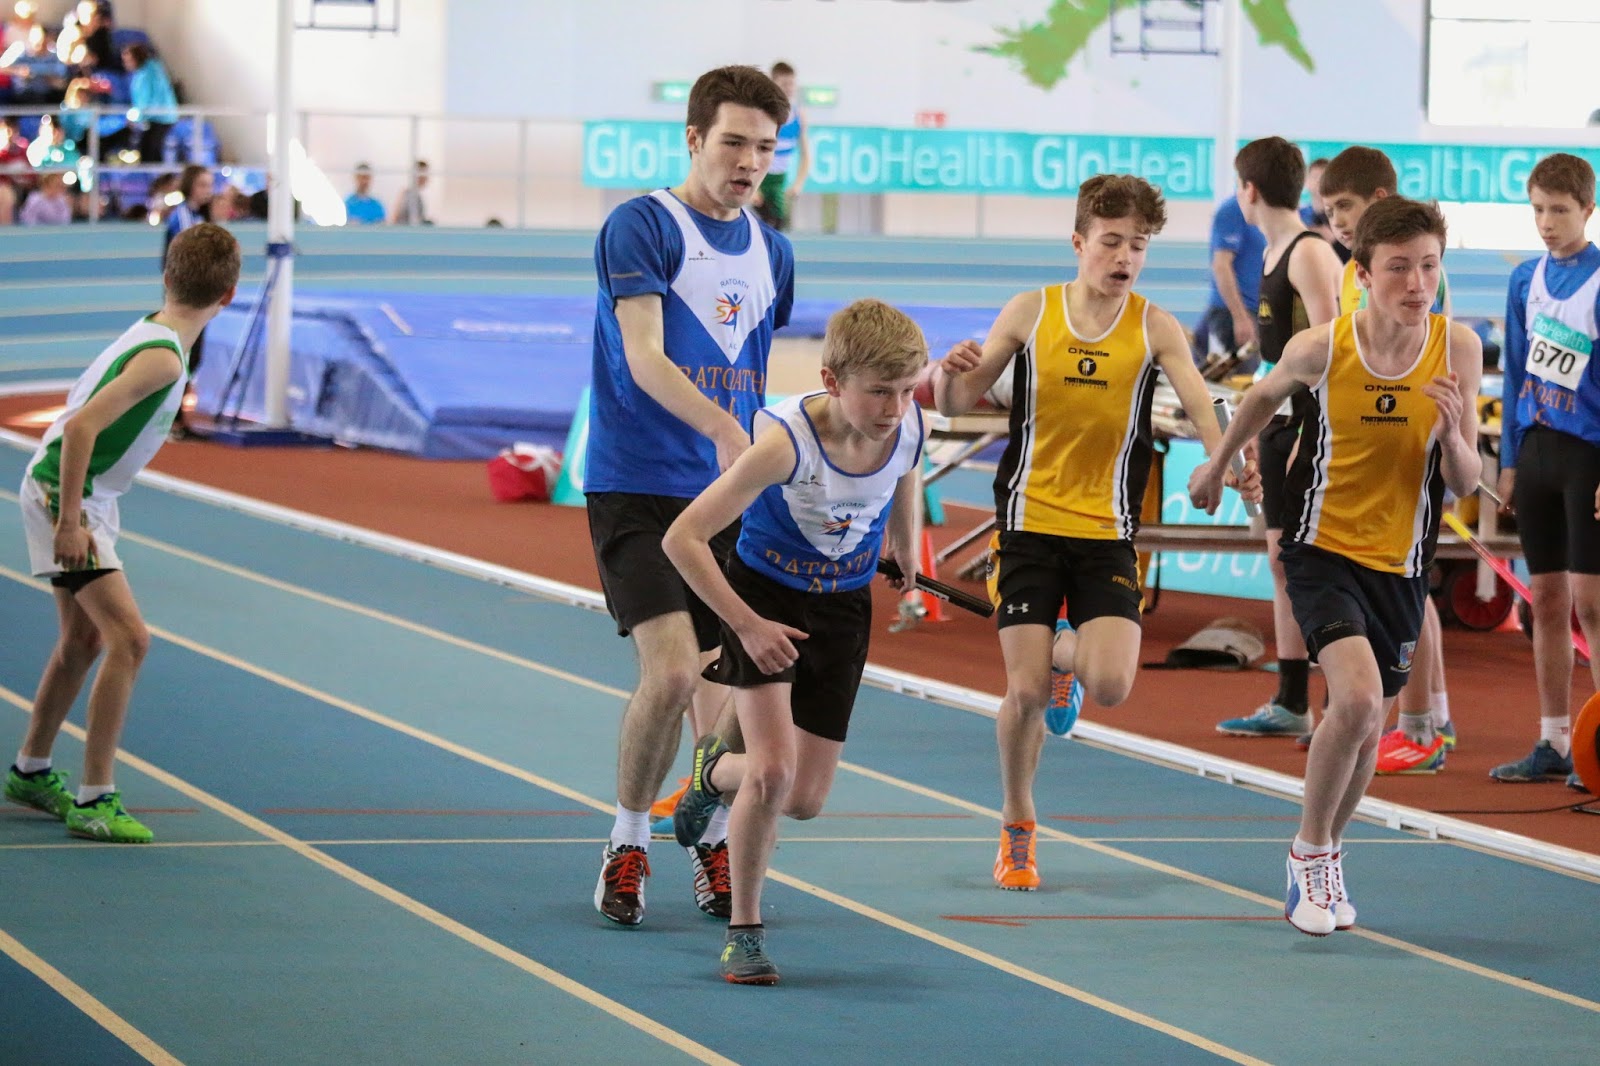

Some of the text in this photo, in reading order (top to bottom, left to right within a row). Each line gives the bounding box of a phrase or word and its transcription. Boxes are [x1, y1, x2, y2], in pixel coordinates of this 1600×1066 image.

[808, 130, 1023, 187] GloHealth
[719, 278, 750, 290] RATOATH
[1532, 340, 1576, 375] 670
[830, 501, 867, 513] RATOATH
